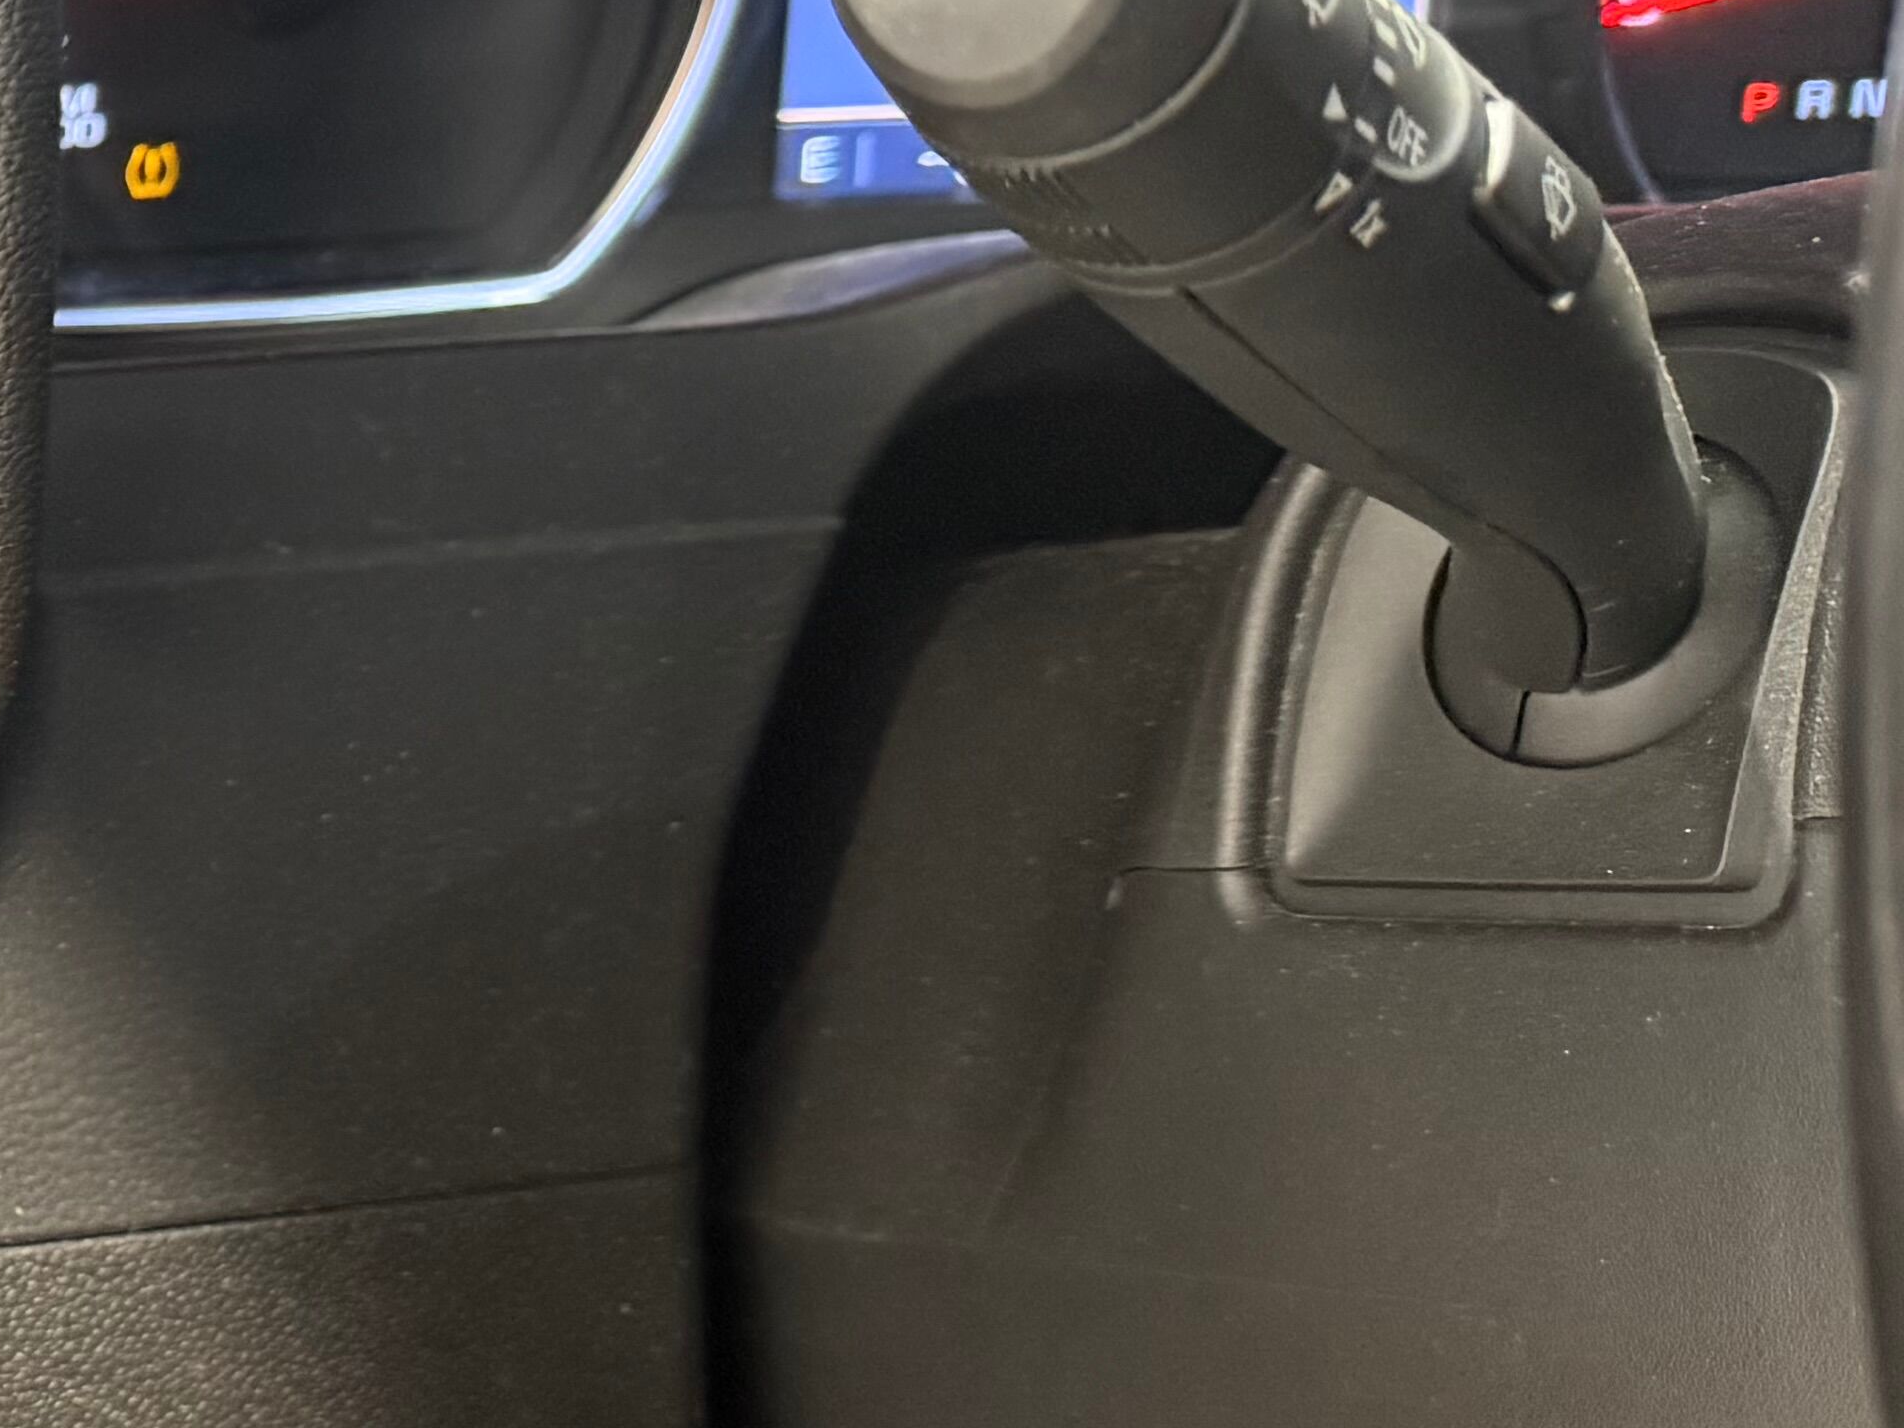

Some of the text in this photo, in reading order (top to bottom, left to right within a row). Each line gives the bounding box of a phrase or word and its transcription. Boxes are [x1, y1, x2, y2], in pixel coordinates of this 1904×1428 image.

[1741, 82, 1780, 123] P
[1849, 78, 1888, 119] N
[1387, 106, 1429, 166] OFF
